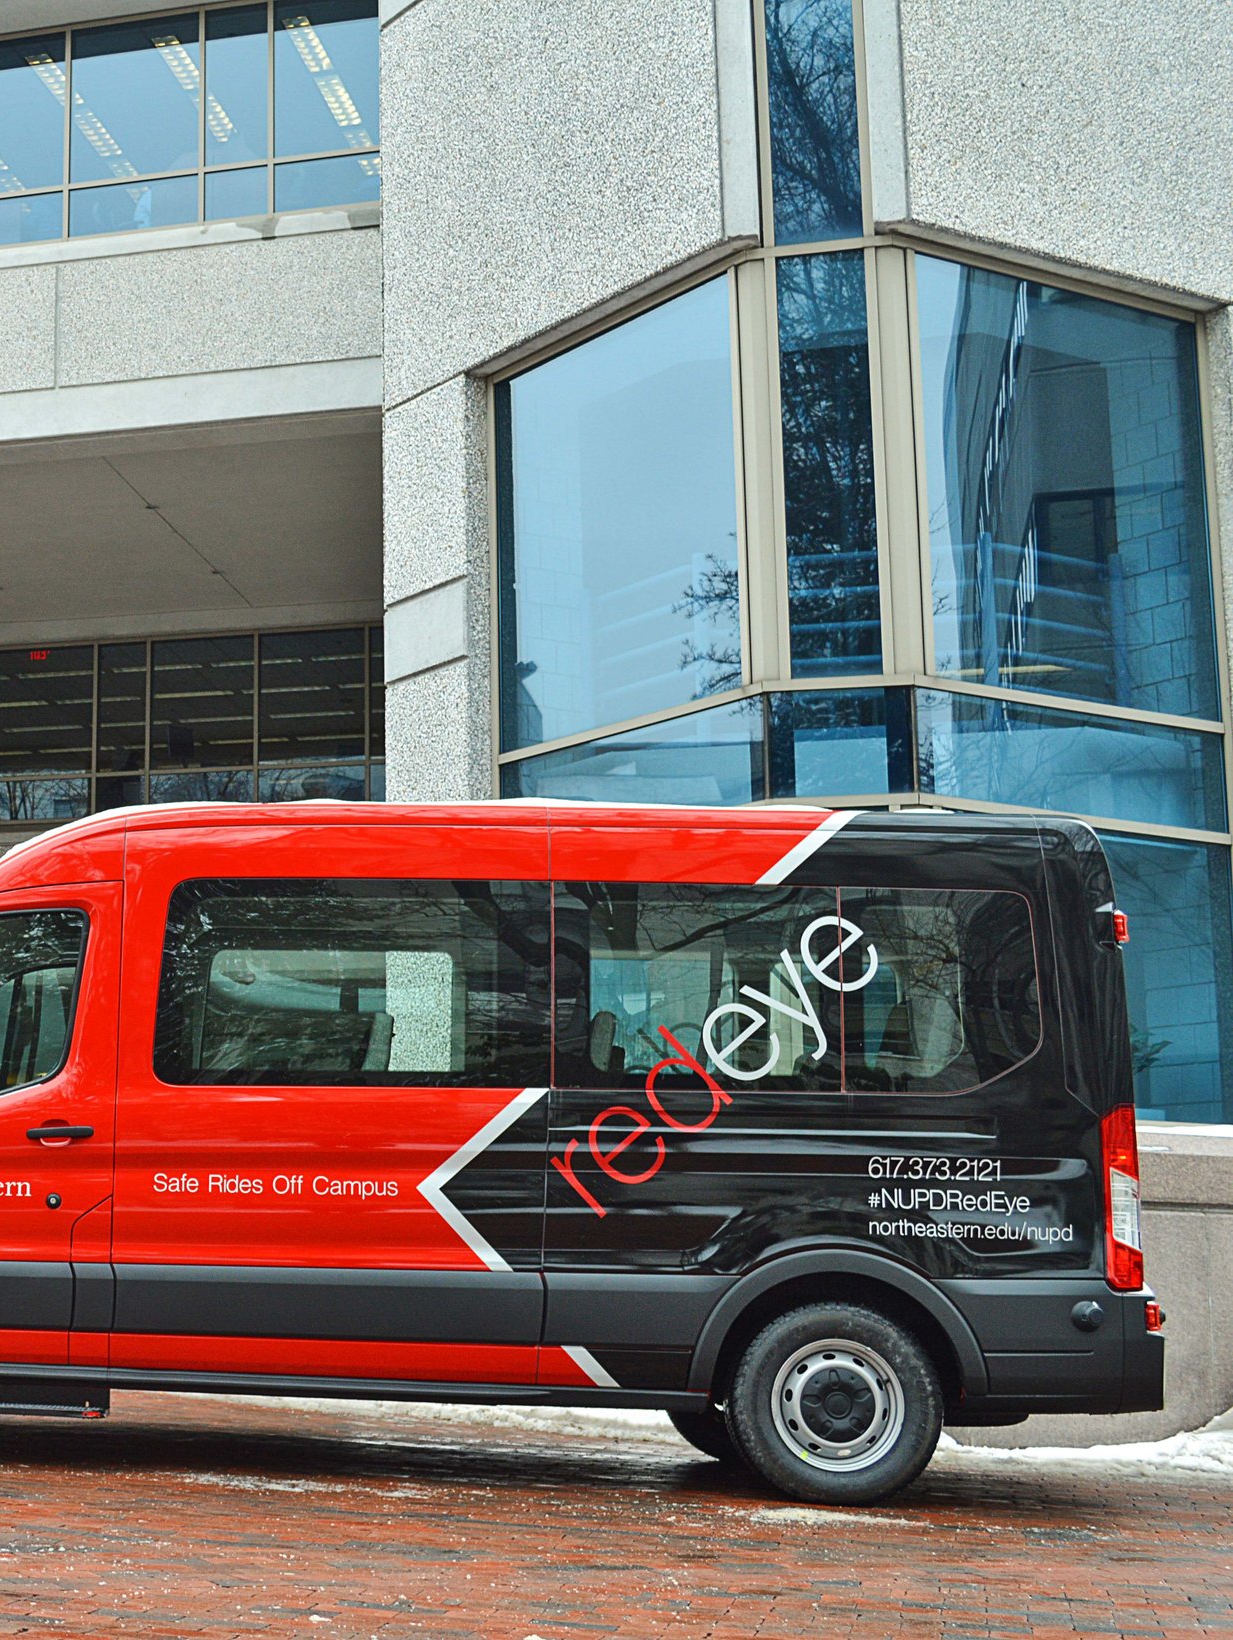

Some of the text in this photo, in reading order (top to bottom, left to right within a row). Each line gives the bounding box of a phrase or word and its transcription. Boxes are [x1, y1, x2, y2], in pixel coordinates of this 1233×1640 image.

[550, 915, 878, 1218] redeye
[867, 1156, 1002, 1182] 617.373.2121
[153, 1173, 399, 1200] Safe Rides Off Campus
[867, 1188, 1030, 1216] #NUPDRedEye
[868, 1218, 1074, 1244] northeastern.edu/nupd
